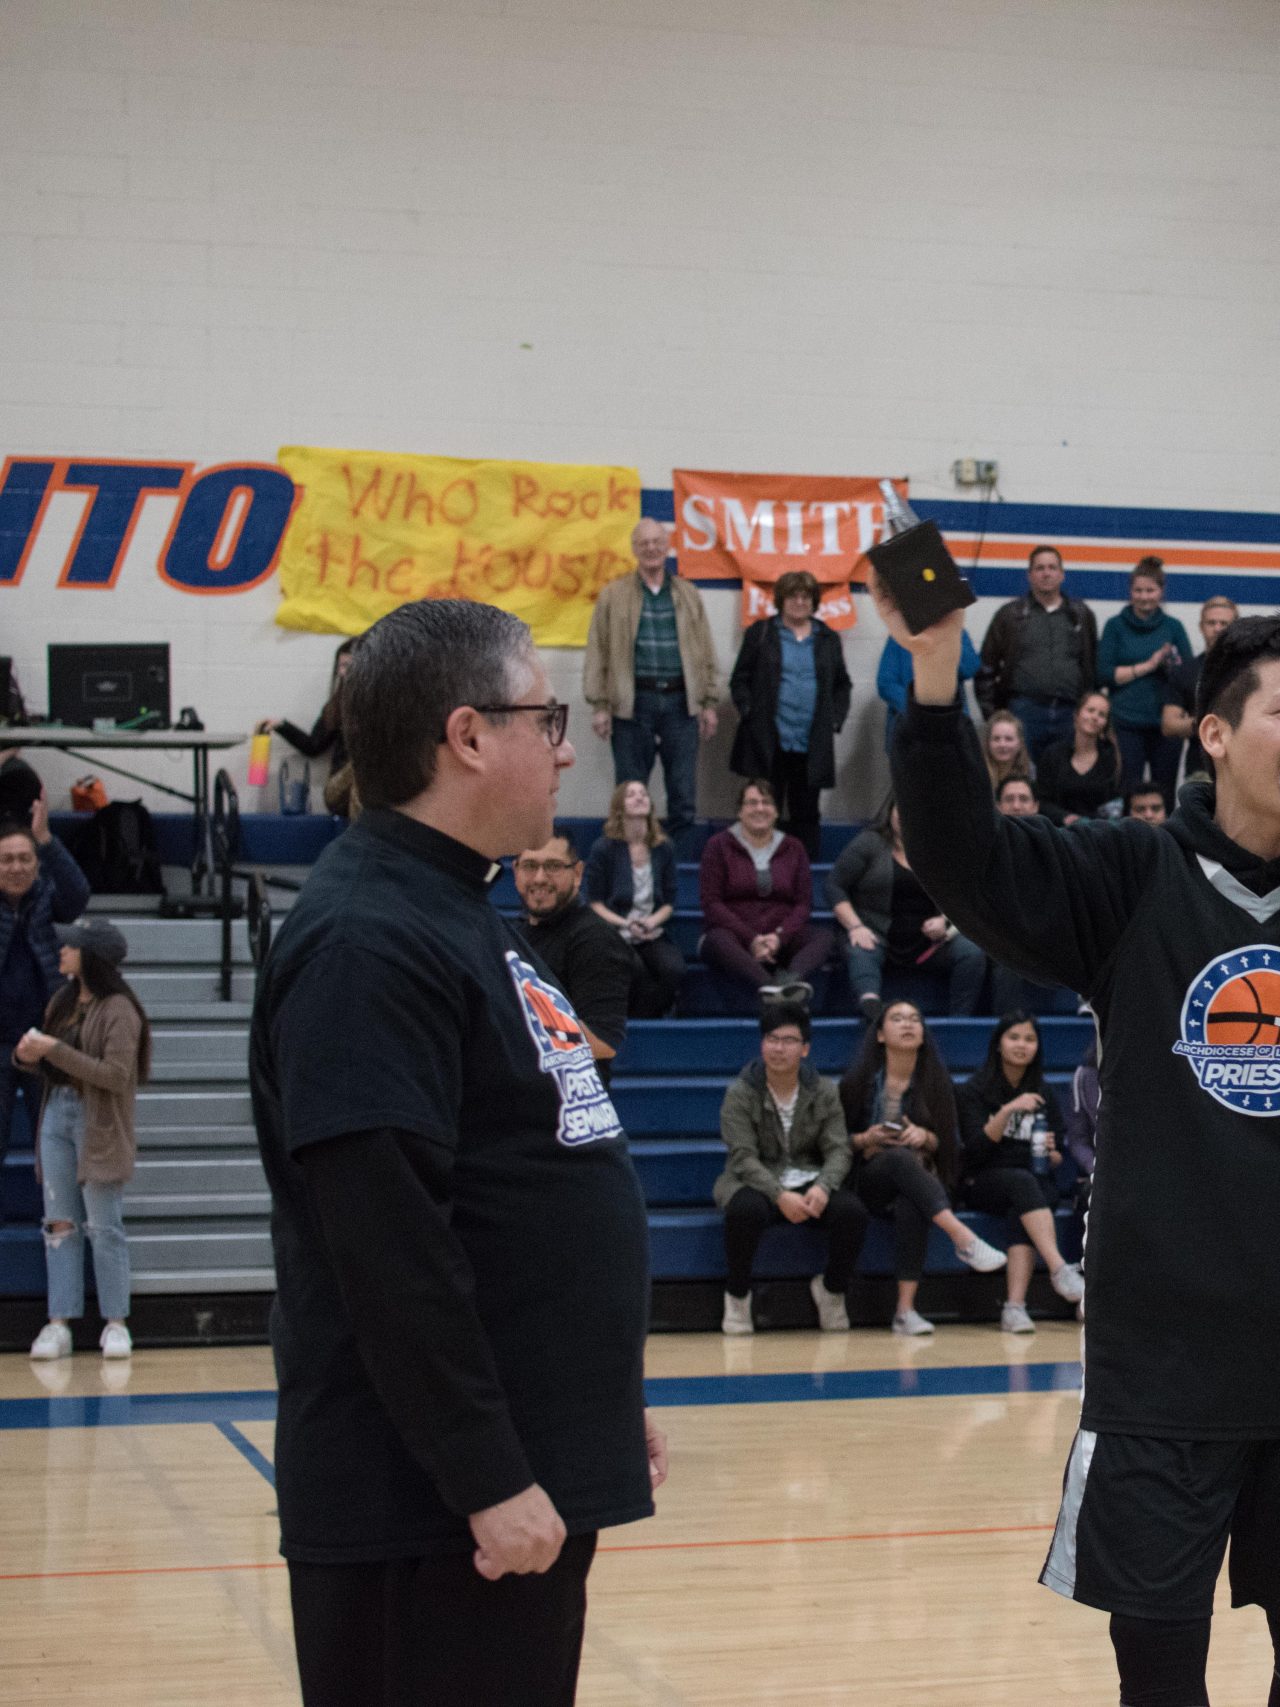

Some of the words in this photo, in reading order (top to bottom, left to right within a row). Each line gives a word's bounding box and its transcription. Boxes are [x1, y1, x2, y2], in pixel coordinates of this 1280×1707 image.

[0, 456, 300, 595] ITO
[1176, 1043, 1255, 1058] ARCHDIOCESE
[1258, 1046, 1273, 1057] OF
